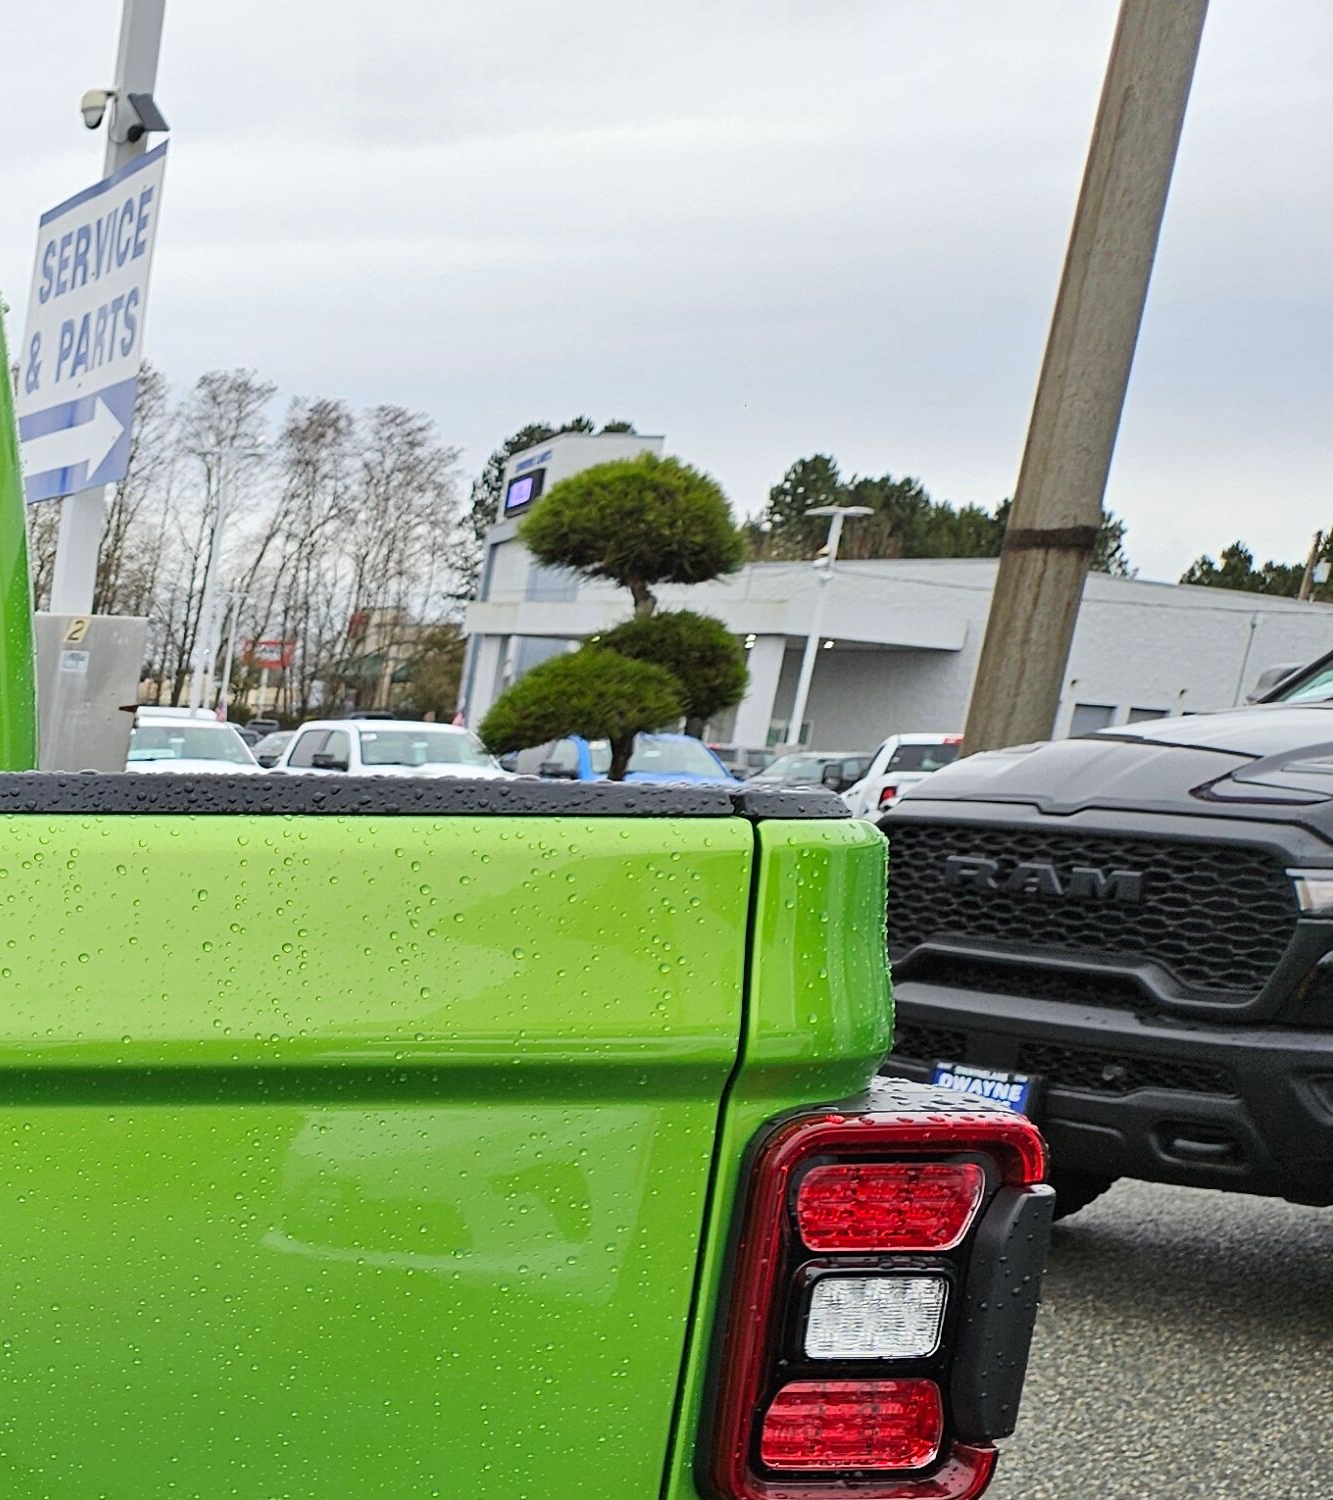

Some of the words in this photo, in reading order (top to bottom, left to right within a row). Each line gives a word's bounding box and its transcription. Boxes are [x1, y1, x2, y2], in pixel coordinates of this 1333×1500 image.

[39, 186, 153, 304] SERVICE
[25, 331, 42, 395] &
[55, 287, 139, 383] PARTS
[67, 619, 85, 641] 2
[944, 855, 1144, 904] RAM
[937, 1072, 1024, 1103] DWAYNE
